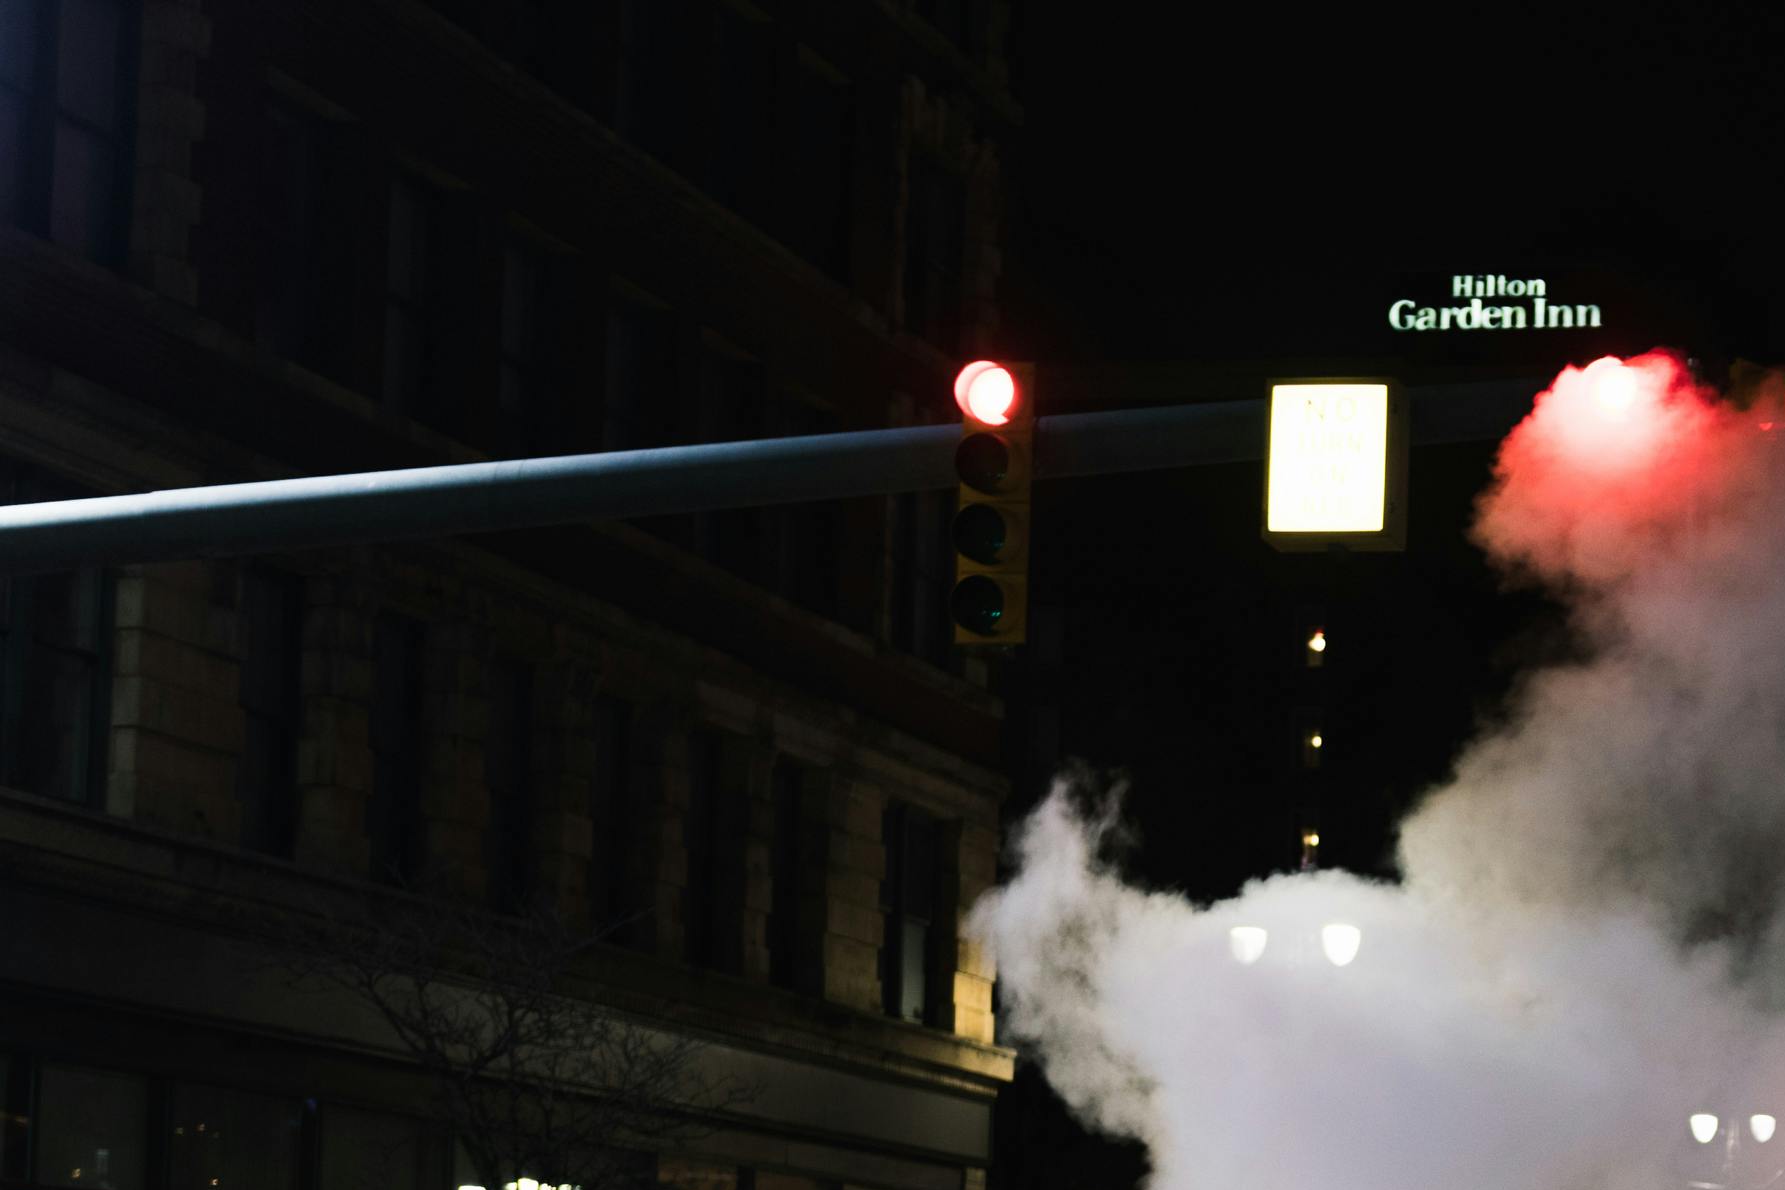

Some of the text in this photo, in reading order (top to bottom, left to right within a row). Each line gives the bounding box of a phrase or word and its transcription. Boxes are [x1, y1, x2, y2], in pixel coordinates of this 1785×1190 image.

[1453, 274, 1546, 297] Hilton
[1388, 297, 1602, 330] Garden Inn
